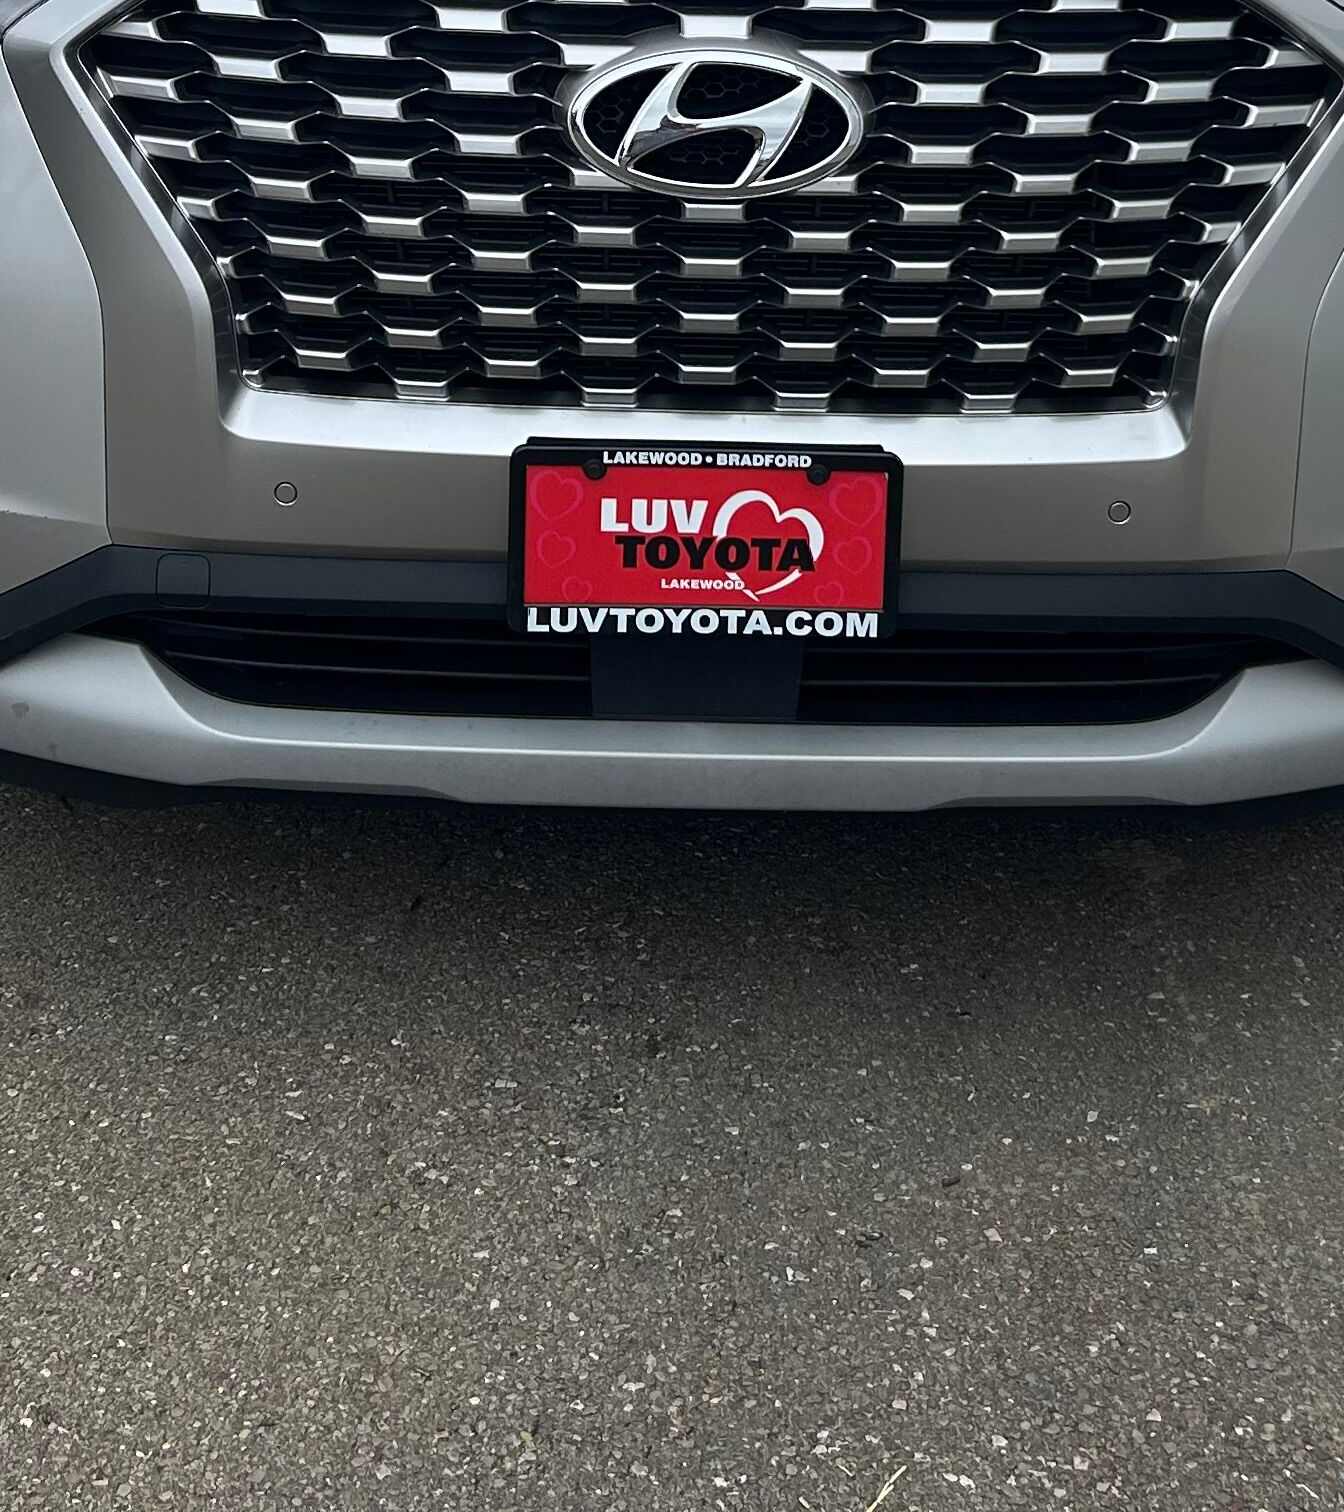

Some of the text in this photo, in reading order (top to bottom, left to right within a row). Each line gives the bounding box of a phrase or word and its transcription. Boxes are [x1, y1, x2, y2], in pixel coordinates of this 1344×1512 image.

[602, 450, 812, 468] LAKEWOOD BRADFORD
[600, 497, 709, 534] LUV
[614, 535, 816, 572] TOYOTA
[660, 578, 745, 591] LAKEWOOD
[527, 607, 878, 638] LUVTOYOTA.COM
